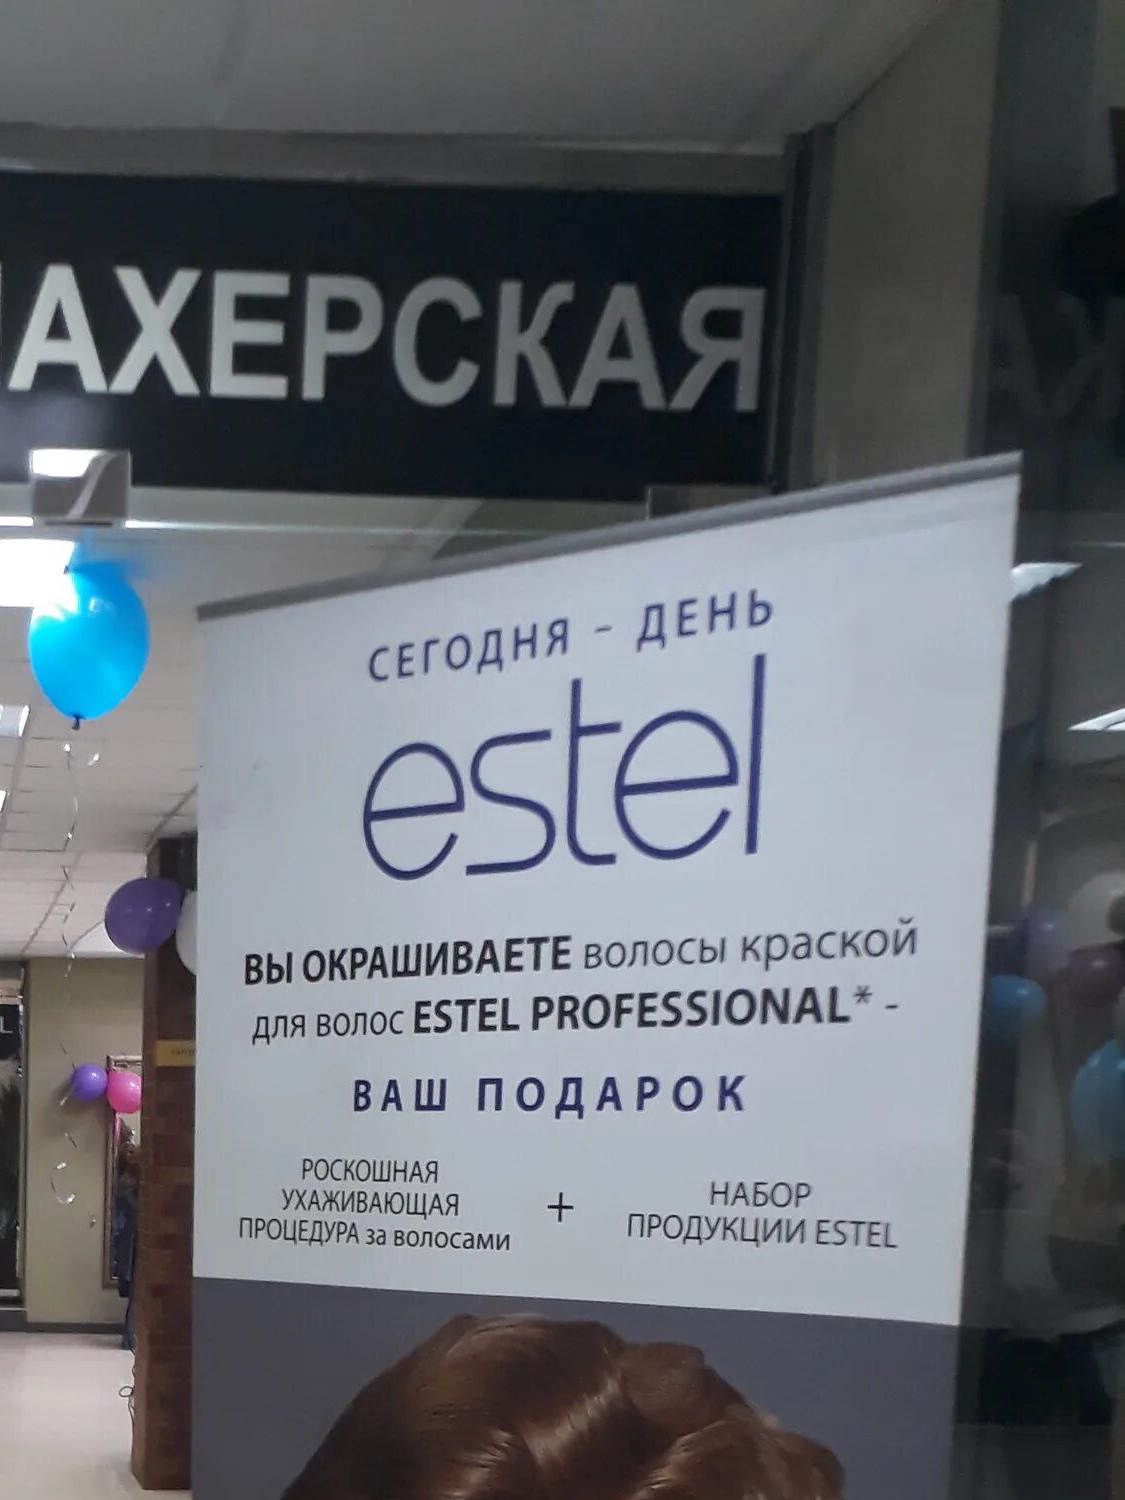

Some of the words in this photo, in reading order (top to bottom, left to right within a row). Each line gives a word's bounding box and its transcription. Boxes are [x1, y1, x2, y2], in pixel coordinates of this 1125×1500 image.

[368, 618, 570, 683] СЕГОДНЯ
[637, 589, 773, 651] ДЕНЬ
[363, 653, 767, 881] estel
[245, 951, 293, 985] ВЫ
[302, 935, 572, 983] ОКРАШИВАЕТЕ
[584, 936, 726, 969] волосы
[741, 917, 918, 972] краской
[252, 1014, 306, 1045] для
[316, 1010, 405, 1038] волос
[413, 997, 520, 1034] ESTEL
[354, 1078, 447, 1112] ВАШ
[478, 1075, 746, 1119] ПОДАРОК
[302, 1158, 439, 1183] РОСКОШНАЯ
[281, 1188, 459, 1220] УХАЖИВАЮЩАЯ
[710, 1181, 812, 1208] НАБОР
[239, 1217, 359, 1245] ПРОЦЕДУРА
[365, 1226, 386, 1246] за
[393, 1229, 511, 1251] волосами
[627, 1213, 806, 1247] ПРОДУКЦИИ
[815, 1219, 899, 1248] ESTEL
